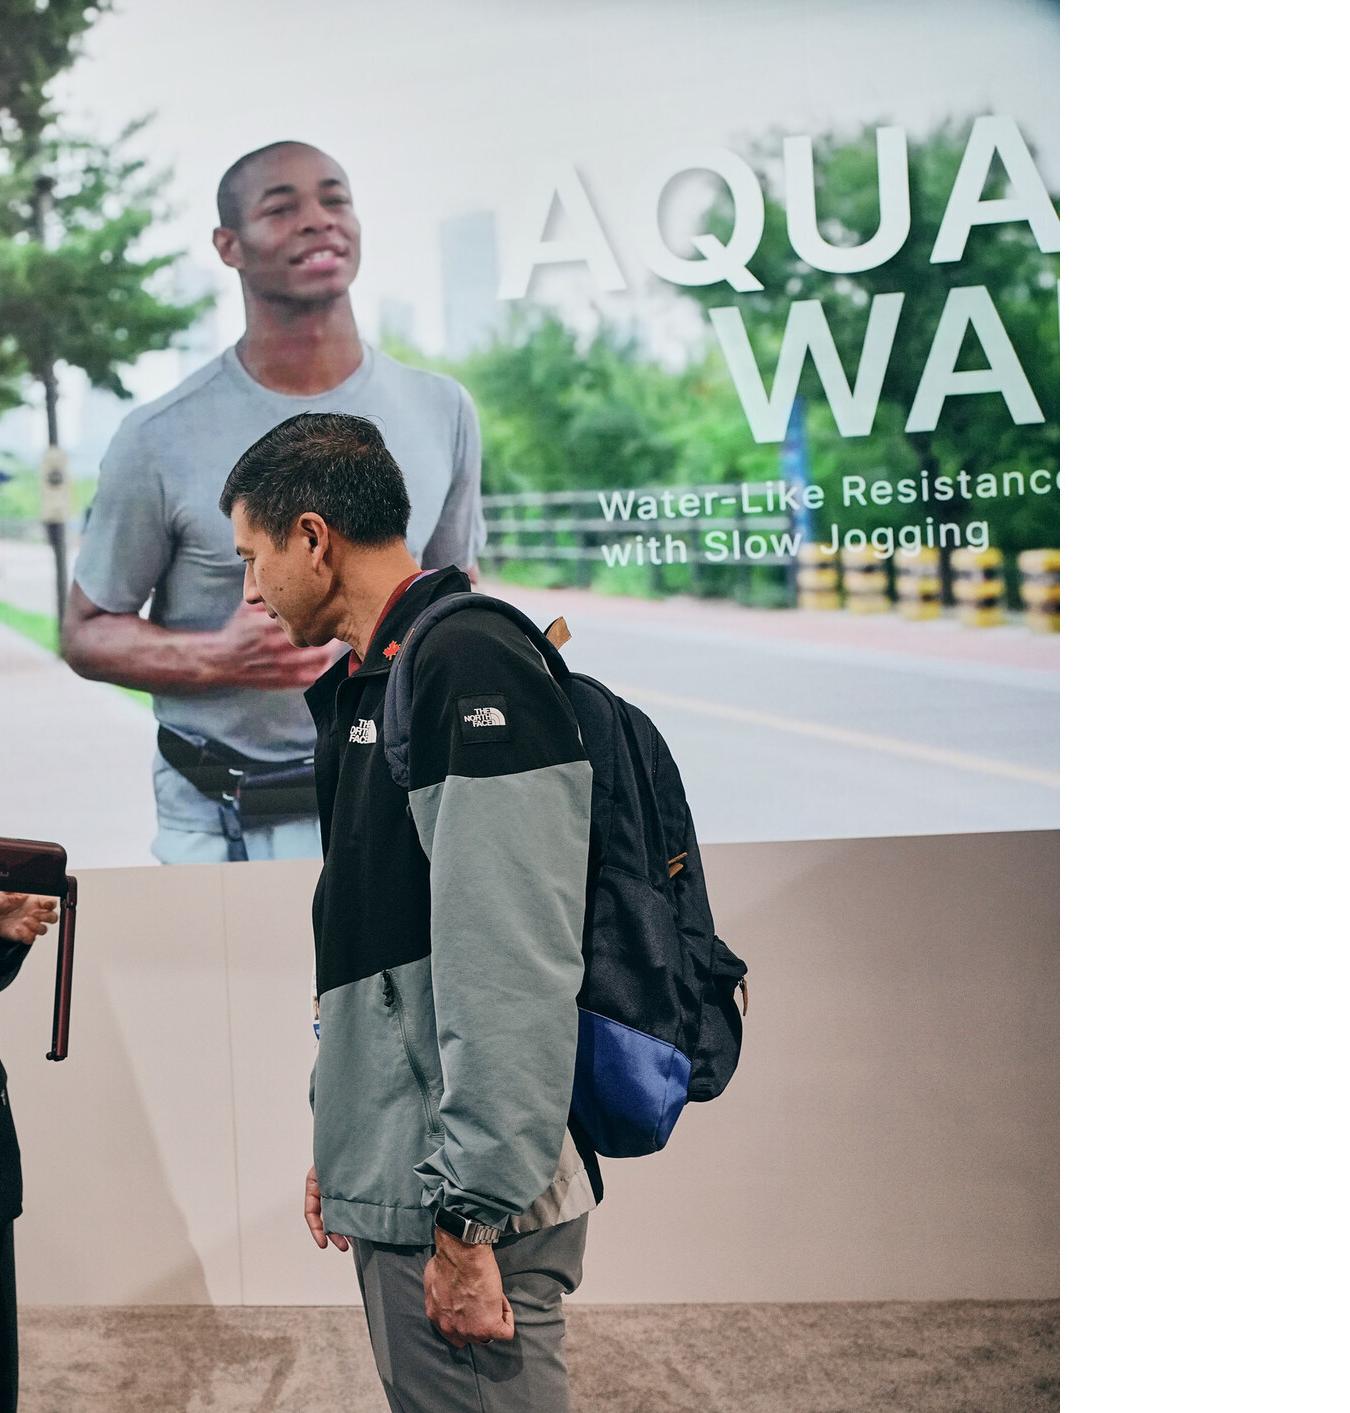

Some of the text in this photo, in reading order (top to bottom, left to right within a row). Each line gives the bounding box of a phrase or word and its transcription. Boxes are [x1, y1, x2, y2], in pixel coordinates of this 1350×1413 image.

[497, 114, 1060, 300] AQUA
[708, 279, 1060, 444] WA
[597, 468, 1060, 522] Water-Like Resistanc
[600, 515, 991, 568] with Slow Jogging
[463, 714, 491, 723] NORTH
[472, 720, 493, 728] FACE
[473, 707, 491, 715] THE
